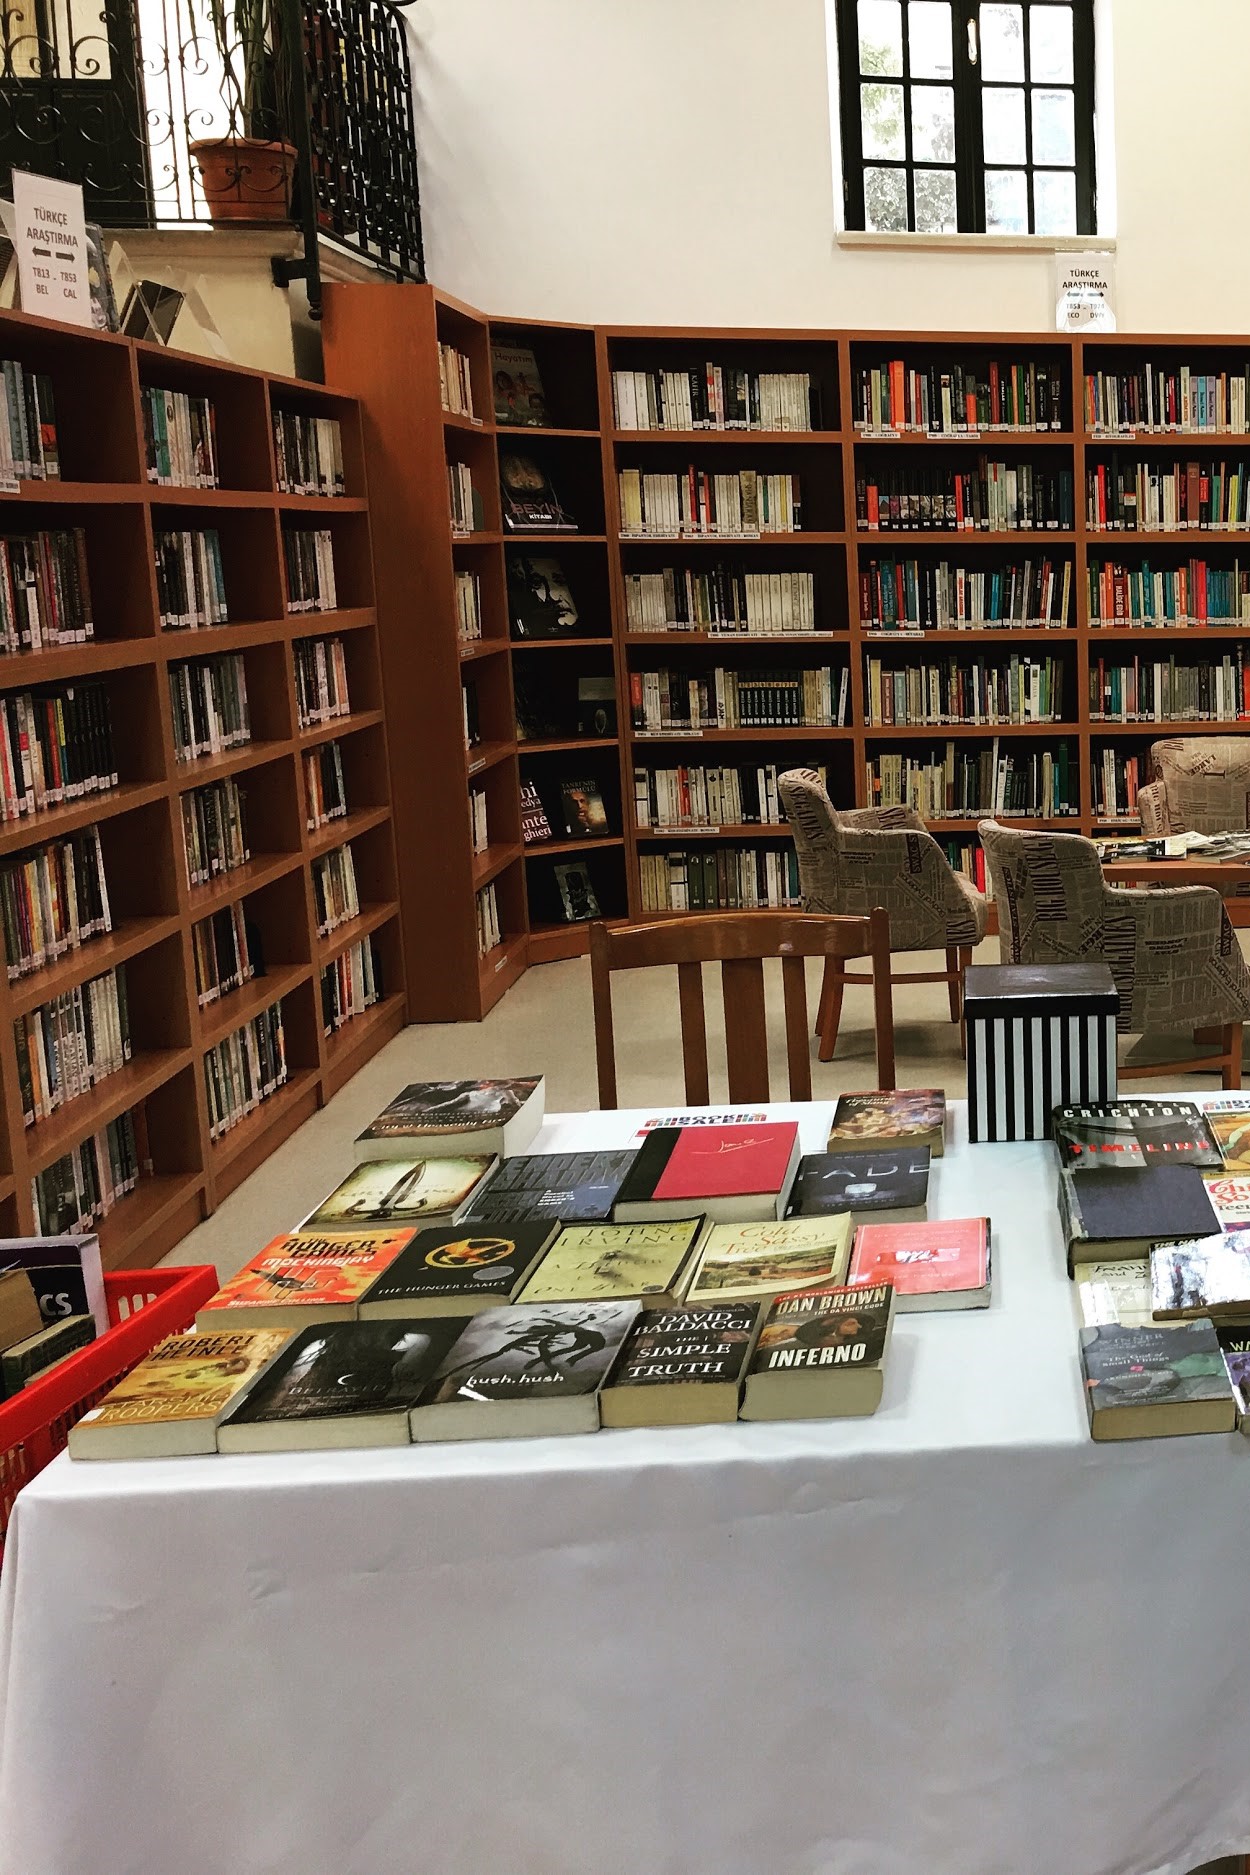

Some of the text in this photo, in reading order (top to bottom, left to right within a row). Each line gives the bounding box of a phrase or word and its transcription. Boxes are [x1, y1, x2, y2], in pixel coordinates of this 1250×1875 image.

[33, 206, 68, 227] TÜRKÇE
[26, 227, 78, 247] ARAŞTIRMA
[1070, 269, 1099, 279] TÜRKÇE
[36, 284, 77, 299] BEL CAL
[1062, 281, 1108, 290] ARAŞTIRMA
[511, 502, 563, 515] BEYİN
[1063, 1105, 1193, 1118] CRICHTON
[1068, 1140, 1211, 1155] TIMELINE
[798, 1163, 931, 1181] FADE
[585, 1226, 672, 1238] JOHN
[740, 1224, 801, 1238] Cold
[280, 1238, 377, 1252] HUNGER
[560, 1234, 687, 1247] IRVING
[760, 1232, 826, 1246] Sassy
[289, 1246, 380, 1259] GAMES
[720, 1242, 767, 1255] Tree
[261, 1255, 376, 1269] MOCKINGJAY
[377, 1280, 507, 1296] THE HUNGER GAMES
[39, 1293, 73, 1316] CS
[776, 1286, 888, 1316] DAN BROWN
[864, 1302, 885, 1310] CODE
[658, 1312, 733, 1326] DAVID
[632, 1319, 753, 1337] BALDACCI
[161, 1335, 256, 1351] ROBERT
[150, 1344, 275, 1362] HEINLEIN
[636, 1343, 733, 1360] SIMPLE
[768, 1342, 867, 1369] INFERNO
[627, 1361, 725, 1379] TRUTH
[519, 1372, 565, 1384] hush
